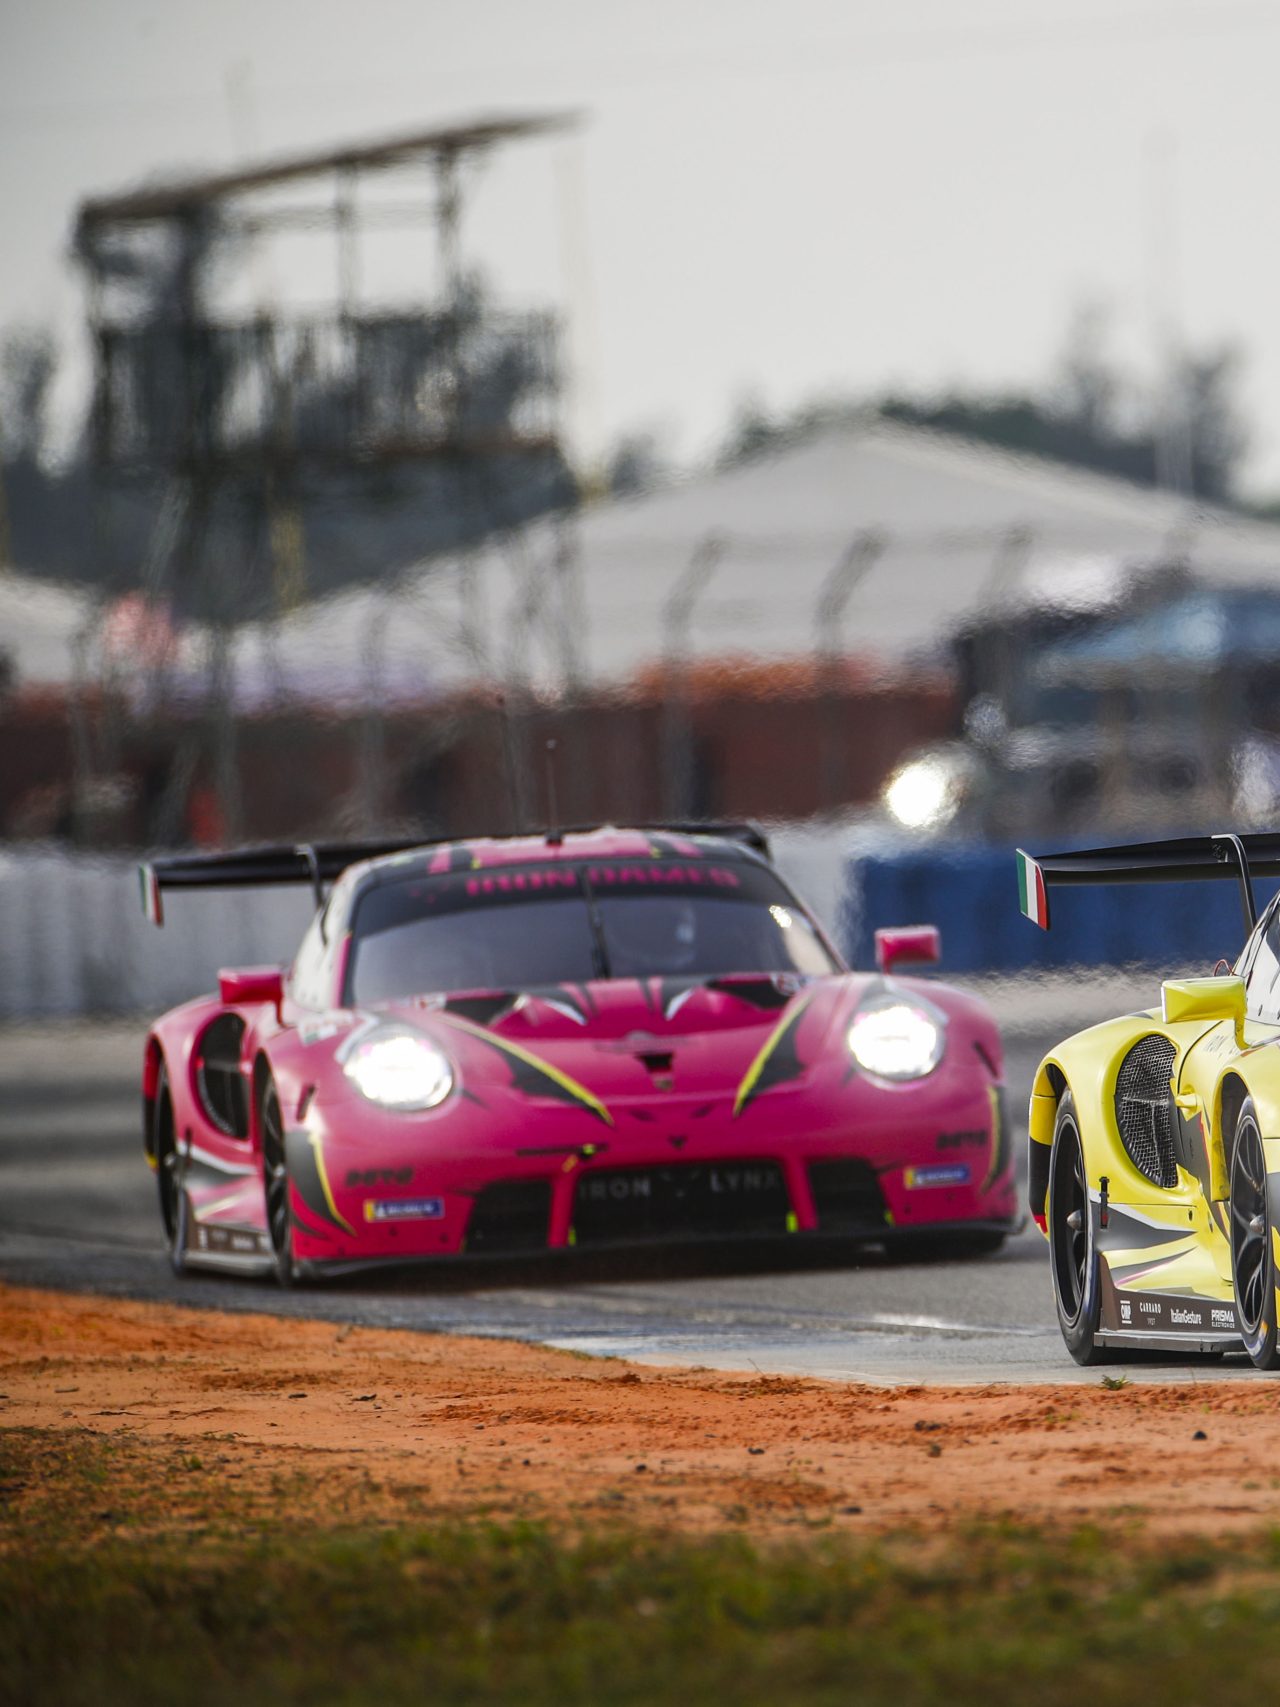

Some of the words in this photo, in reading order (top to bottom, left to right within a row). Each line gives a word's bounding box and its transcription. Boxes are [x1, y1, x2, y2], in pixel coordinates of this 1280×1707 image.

[467, 869, 576, 895] IRON
[1139, 1302, 1162, 1314] CARRARO
[1211, 1309, 1235, 1322] PRISMA
[1170, 1307, 1202, 1325] ItalianGesture
